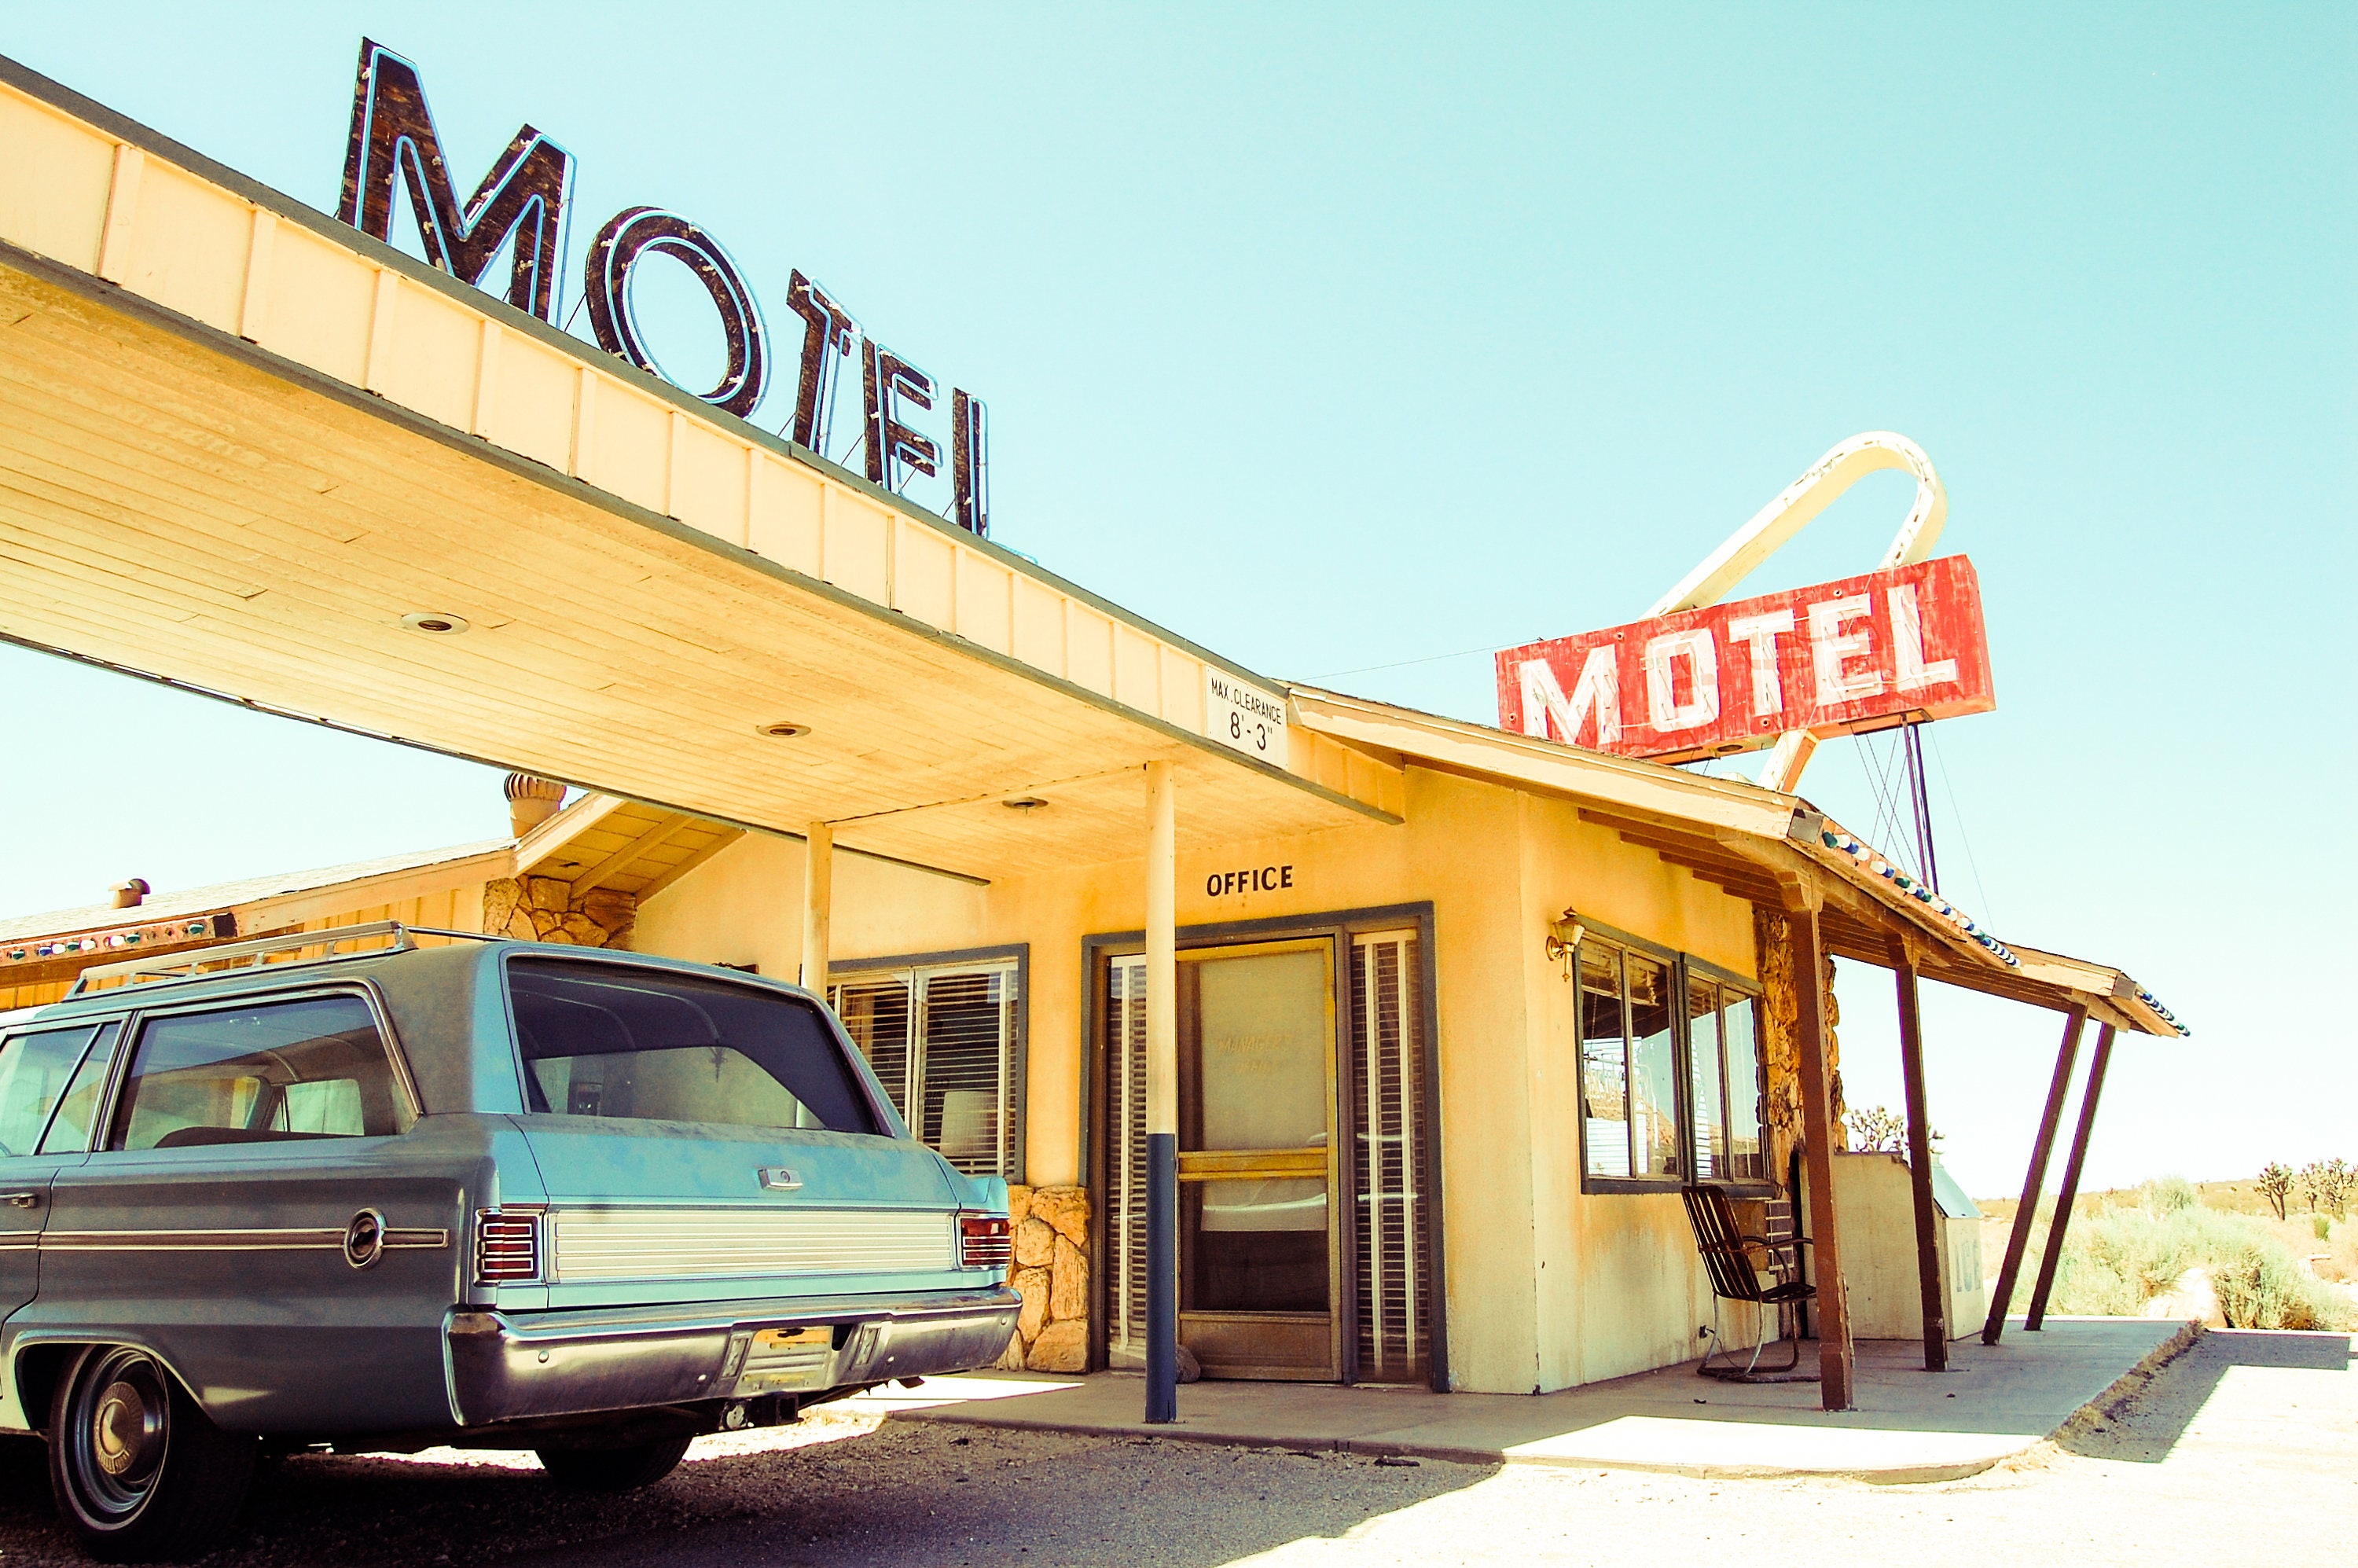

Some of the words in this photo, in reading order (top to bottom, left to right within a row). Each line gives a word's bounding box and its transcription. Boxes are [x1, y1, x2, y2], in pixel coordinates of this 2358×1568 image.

[1519, 584, 1957, 745] MOTEL
[1234, 689, 1282, 725] CLEARANCE
[1207, 865, 1293, 897] OFFICE
